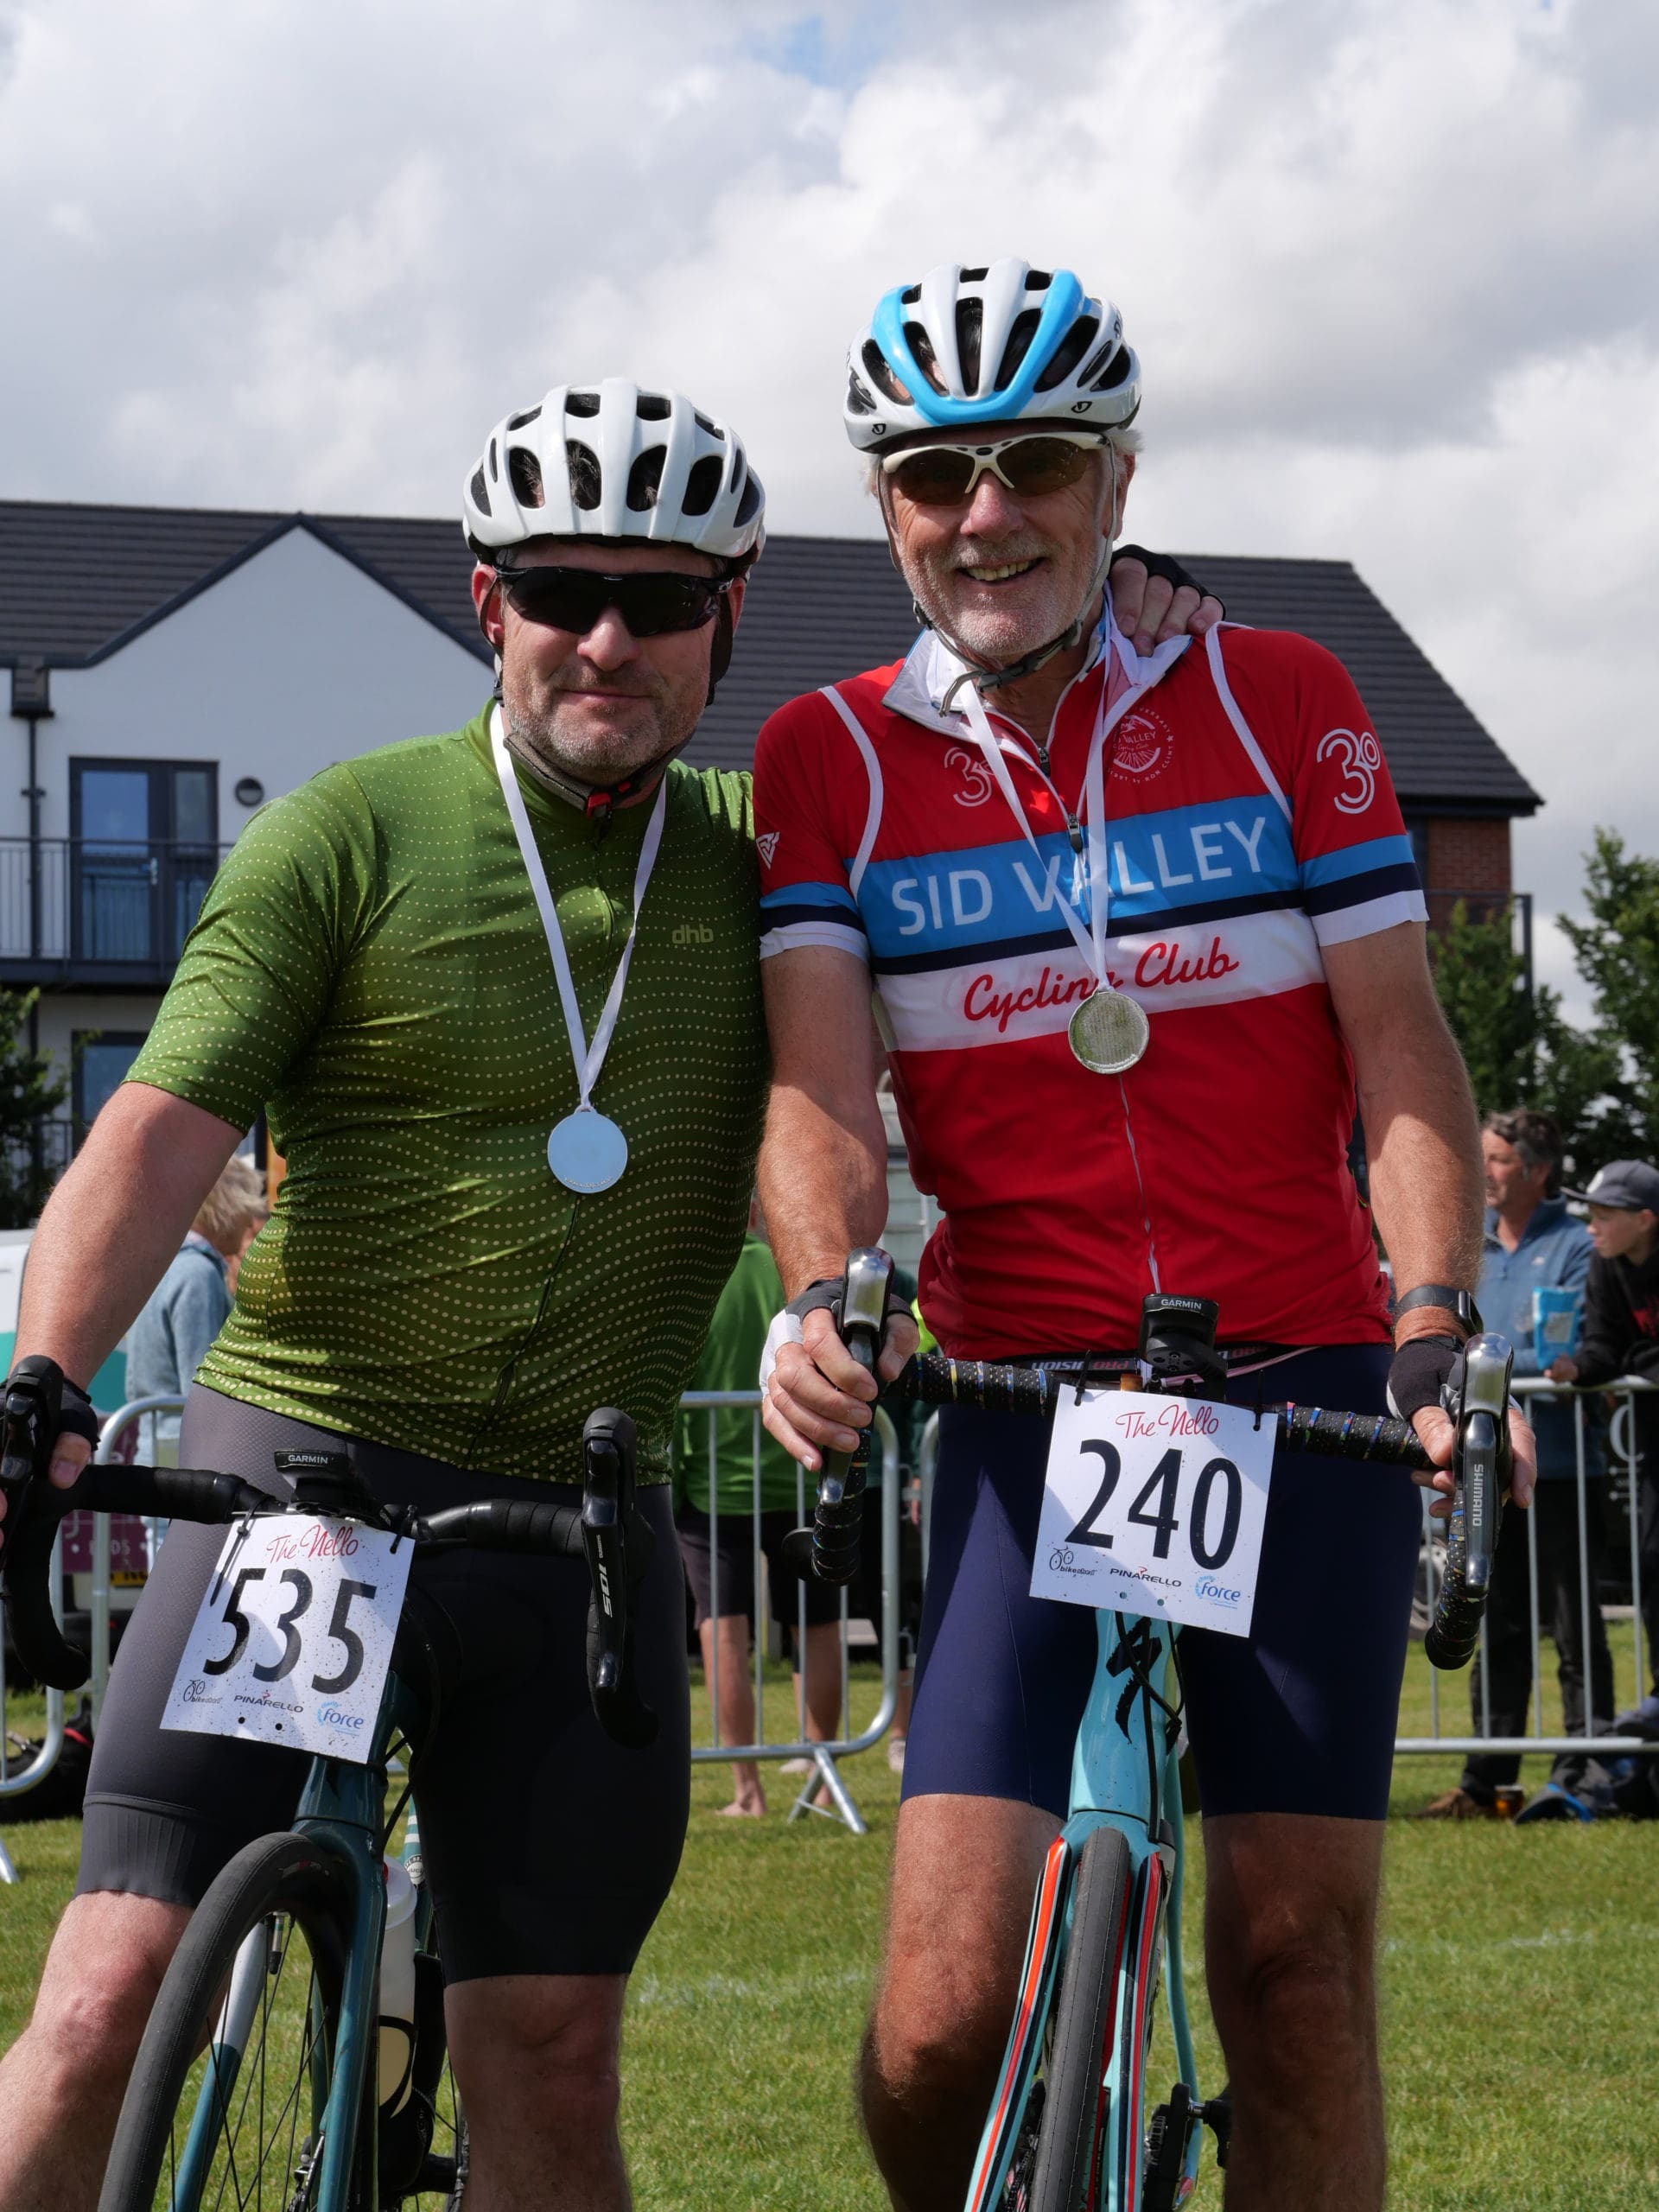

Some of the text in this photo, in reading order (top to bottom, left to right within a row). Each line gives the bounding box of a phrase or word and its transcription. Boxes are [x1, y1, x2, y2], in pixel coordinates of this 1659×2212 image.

[1123, 731, 1156, 744] VALLEY
[891, 869, 993, 937] SID
[671, 923, 714, 944] dhb
[1135, 937, 1239, 988] Club
[1160, 1298, 1202, 1310] GARMIN
[1116, 1404, 1219, 1439] The Nello
[288, 1454, 328, 1465] GARMIN
[1065, 1438, 1243, 1570] 240
[1472, 1464, 1484, 1528] SHIMANO
[266, 1524, 359, 1563] The Nello
[599, 1562, 613, 1618] 105
[1109, 1567, 1182, 1587] PINARELLO
[1201, 1581, 1241, 1603] force
[202, 1567, 378, 1694] 535
[233, 1694, 304, 1713] PINARELLO
[322, 1707, 365, 1730] force
